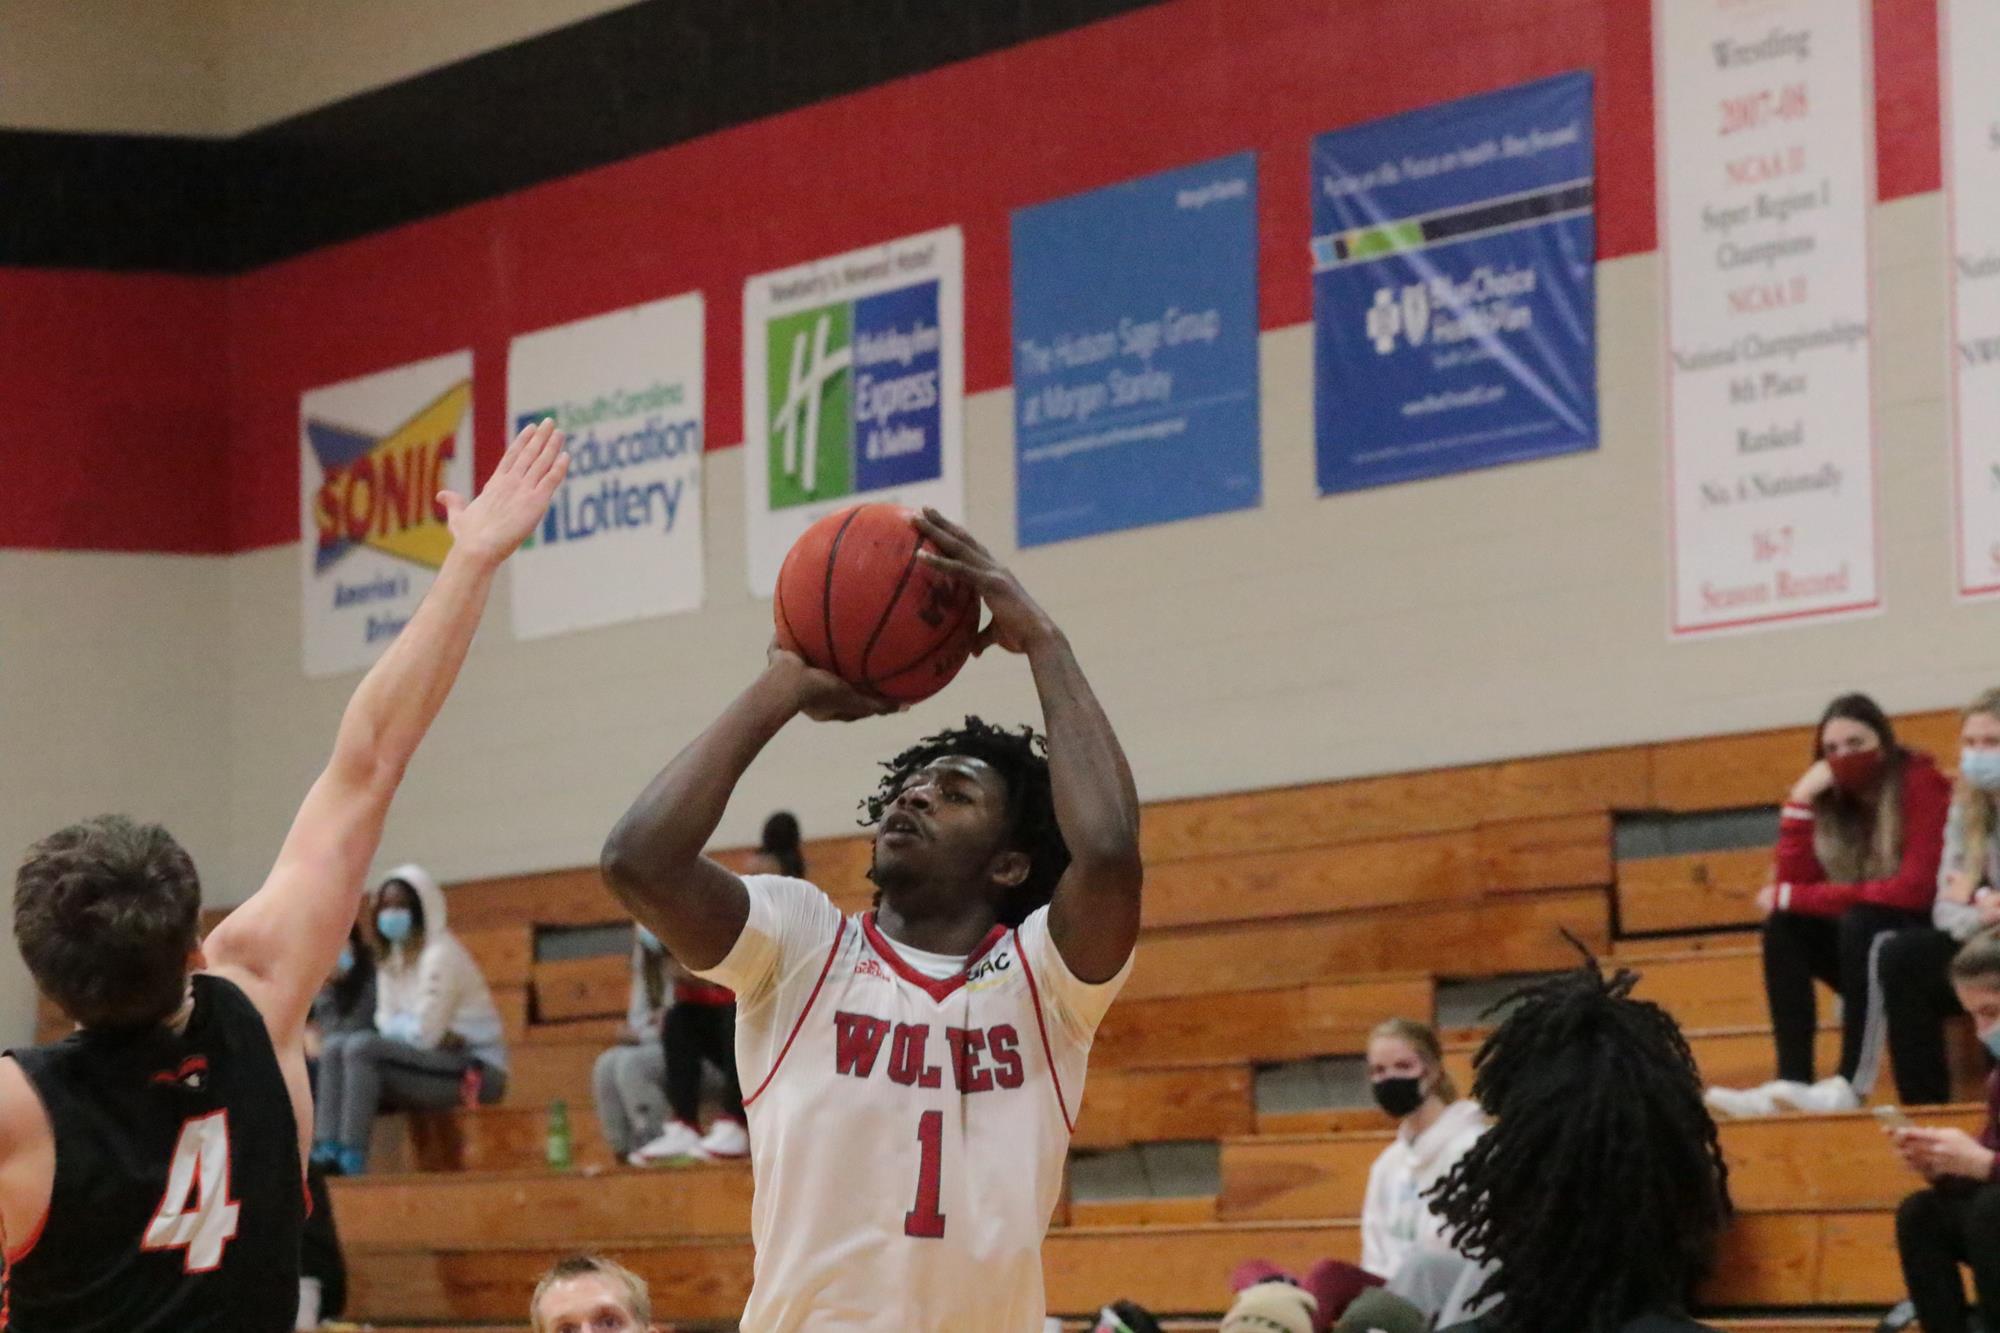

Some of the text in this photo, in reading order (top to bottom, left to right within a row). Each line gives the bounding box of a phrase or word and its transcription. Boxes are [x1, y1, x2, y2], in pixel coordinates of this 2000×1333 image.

[857, 370, 936, 427] Express
[316, 434, 456, 549] SONIC
[564, 415, 697, 480] Education
[562, 477, 684, 541] Lottery
[140, 1107, 241, 1275] 4
[904, 1110, 946, 1239] 1
